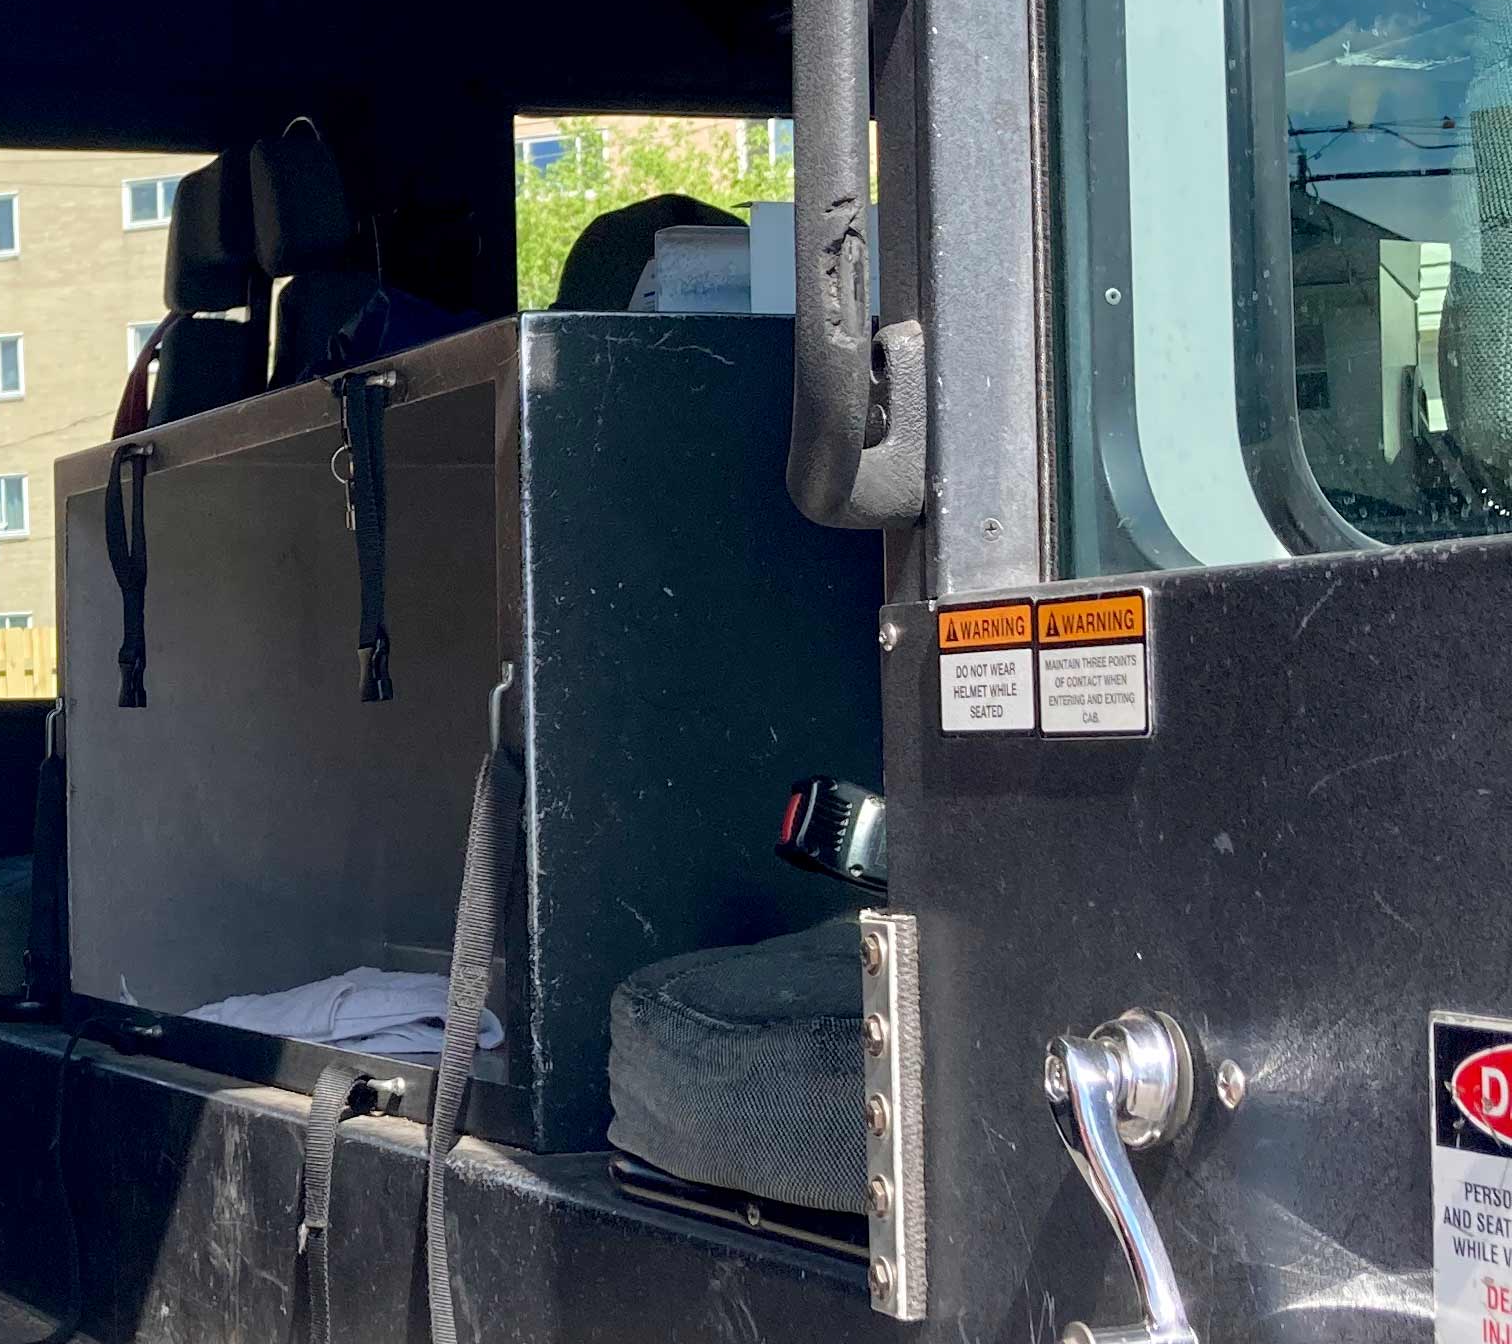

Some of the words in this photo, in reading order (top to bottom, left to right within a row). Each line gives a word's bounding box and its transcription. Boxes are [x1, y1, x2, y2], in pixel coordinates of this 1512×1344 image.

[960, 616, 1025, 640] WARNING
[1061, 609, 1135, 634] WARNING
[956, 665, 968, 678] DO
[970, 664, 988, 678] NOT
[990, 662, 1016, 676] WEAR
[1045, 658, 1081, 671] MAINTAIN
[1082, 656, 1107, 668] THREE
[1108, 655, 1137, 667] POINTS
[1054, 676, 1065, 688] OF
[1066, 675, 1102, 688] CONTACT
[1104, 674, 1127, 686] WHEN
[953, 684, 987, 699] HELMET
[989, 683, 1017, 697] WHILE
[1048, 695, 1085, 706] ENTERING
[1087, 694, 1103, 705] AND
[1105, 692, 1135, 704] EXITING
[970, 705, 1003, 718] SEATED
[1443, 1206, 1472, 1230] AND
[1453, 1236, 1499, 1265] WHILE
